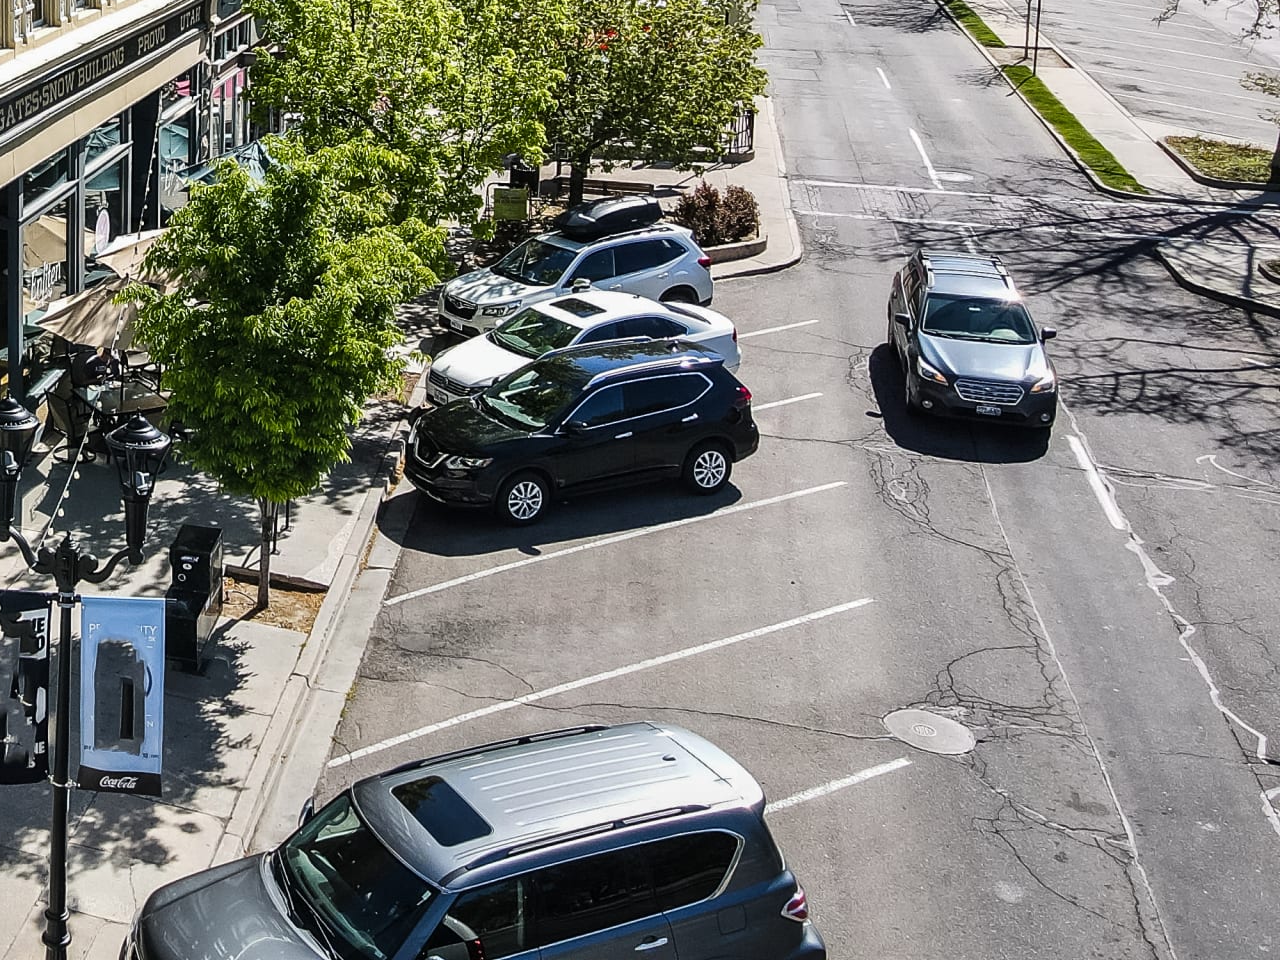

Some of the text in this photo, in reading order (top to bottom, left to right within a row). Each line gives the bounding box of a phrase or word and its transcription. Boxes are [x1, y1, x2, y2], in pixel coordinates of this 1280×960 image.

[78, 46, 125, 87] BUILDING
[138, 25, 166, 55] PROVO
[180, 6, 202, 31] UTAH
